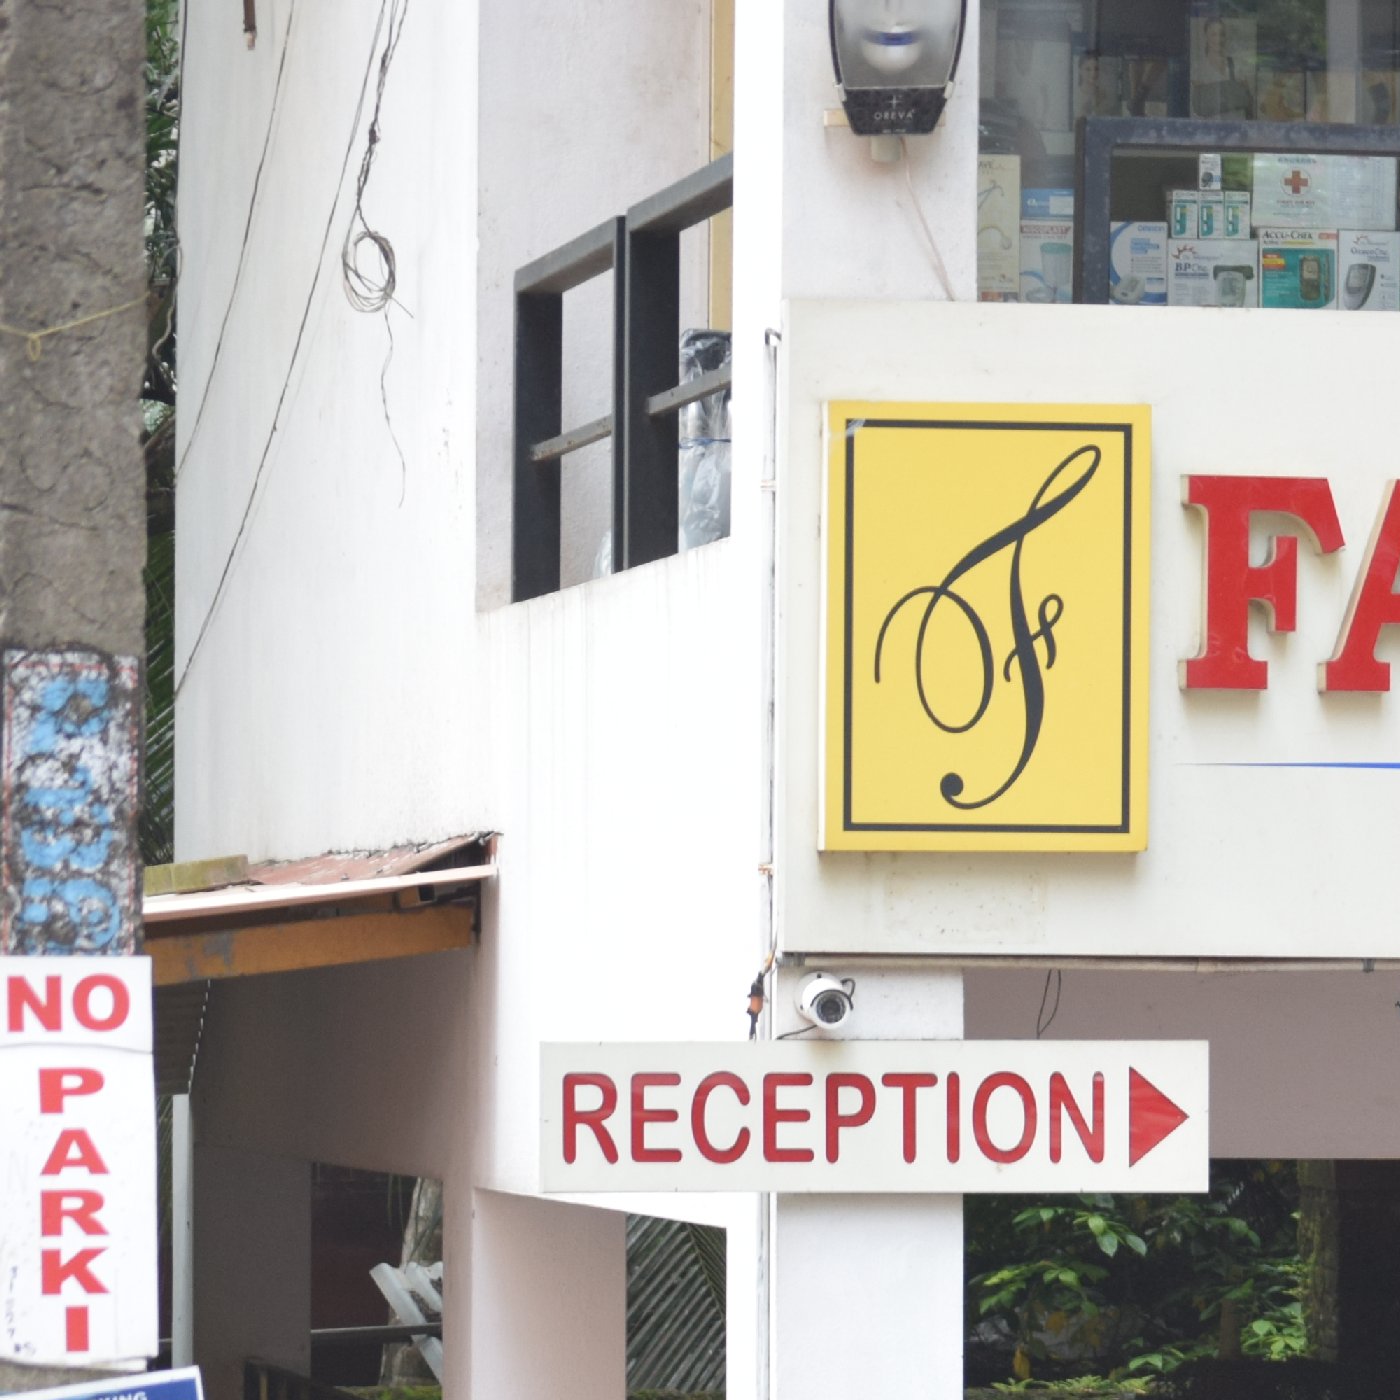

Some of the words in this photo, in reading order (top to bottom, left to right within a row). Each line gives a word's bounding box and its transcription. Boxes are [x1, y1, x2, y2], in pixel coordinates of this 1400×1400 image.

[874, 111, 914, 121] OREVA
[7, 974, 130, 1032] NO
[562, 1071, 1105, 1164] RECEPTION
[39, 1067, 108, 1352] PARKI
